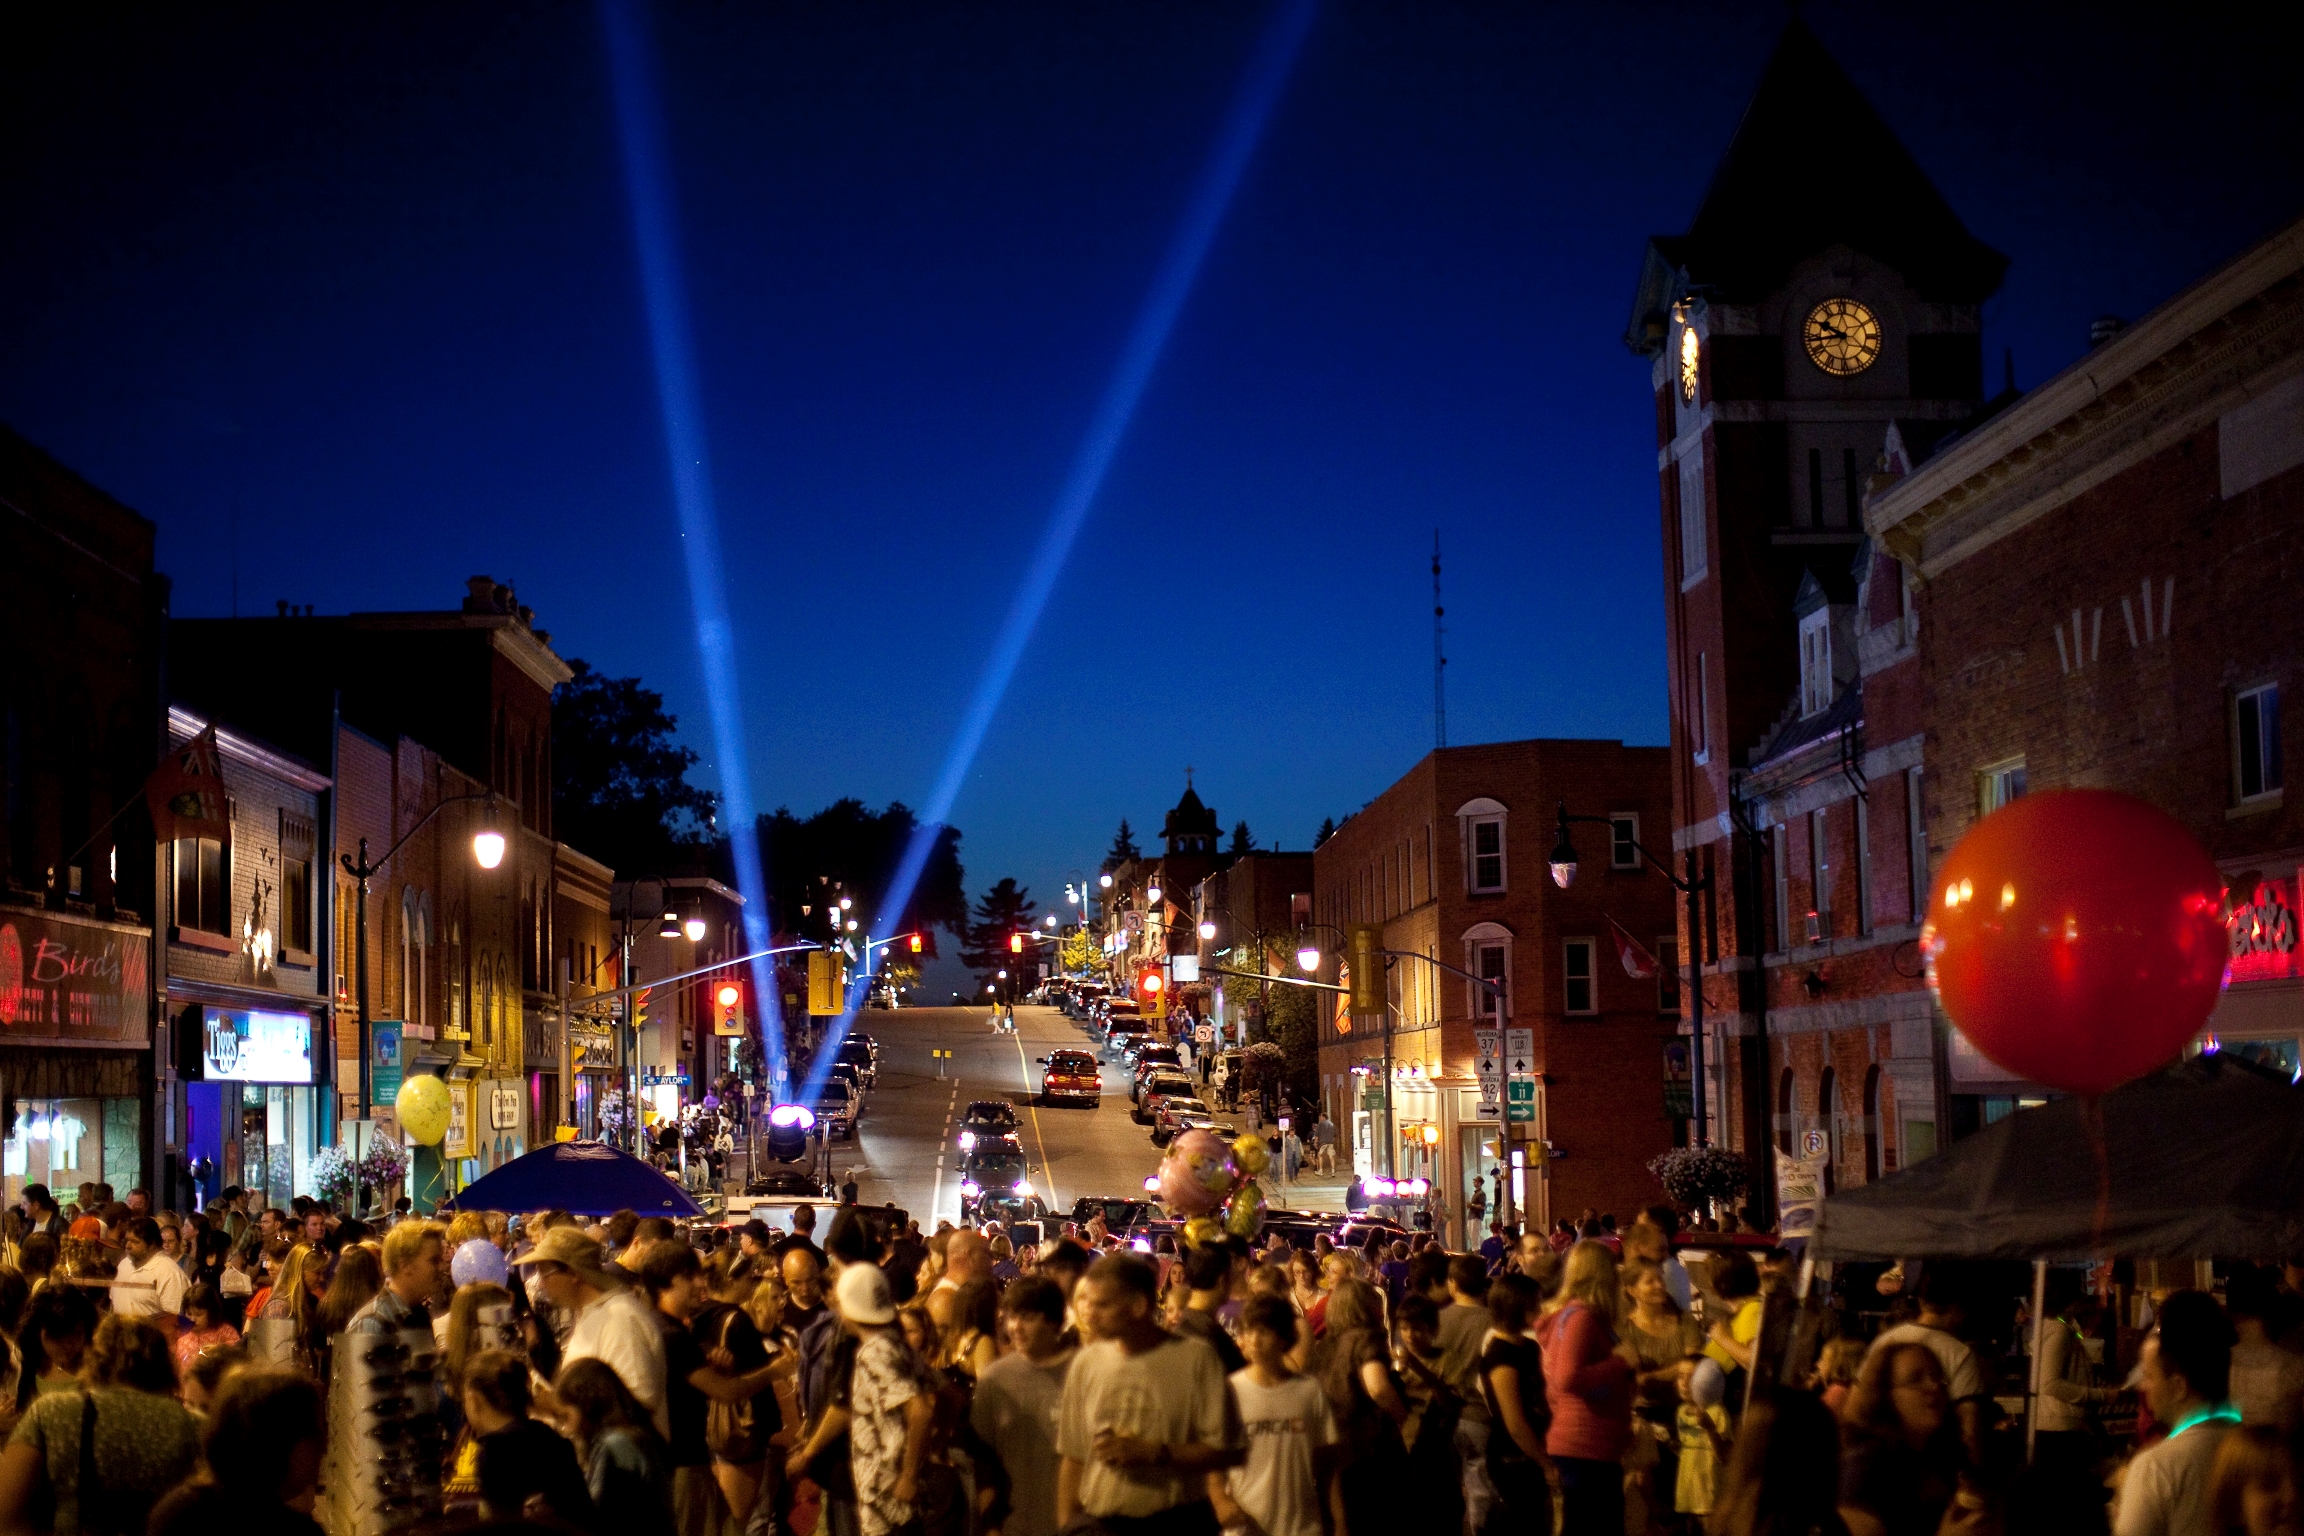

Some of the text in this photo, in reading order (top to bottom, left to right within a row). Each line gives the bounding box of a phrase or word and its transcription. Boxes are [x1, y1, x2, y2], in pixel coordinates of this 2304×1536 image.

[207, 1018, 237, 1072] Tiggs
[1481, 1039, 1494, 1049] 37
[1514, 1040, 1525, 1049] 118
[656, 1076, 683, 1085] AYLOR
[1483, 1084, 1496, 1094] 42
[1519, 1089, 1526, 1099] 11
[1547, 1150, 1560, 1158] LOR
